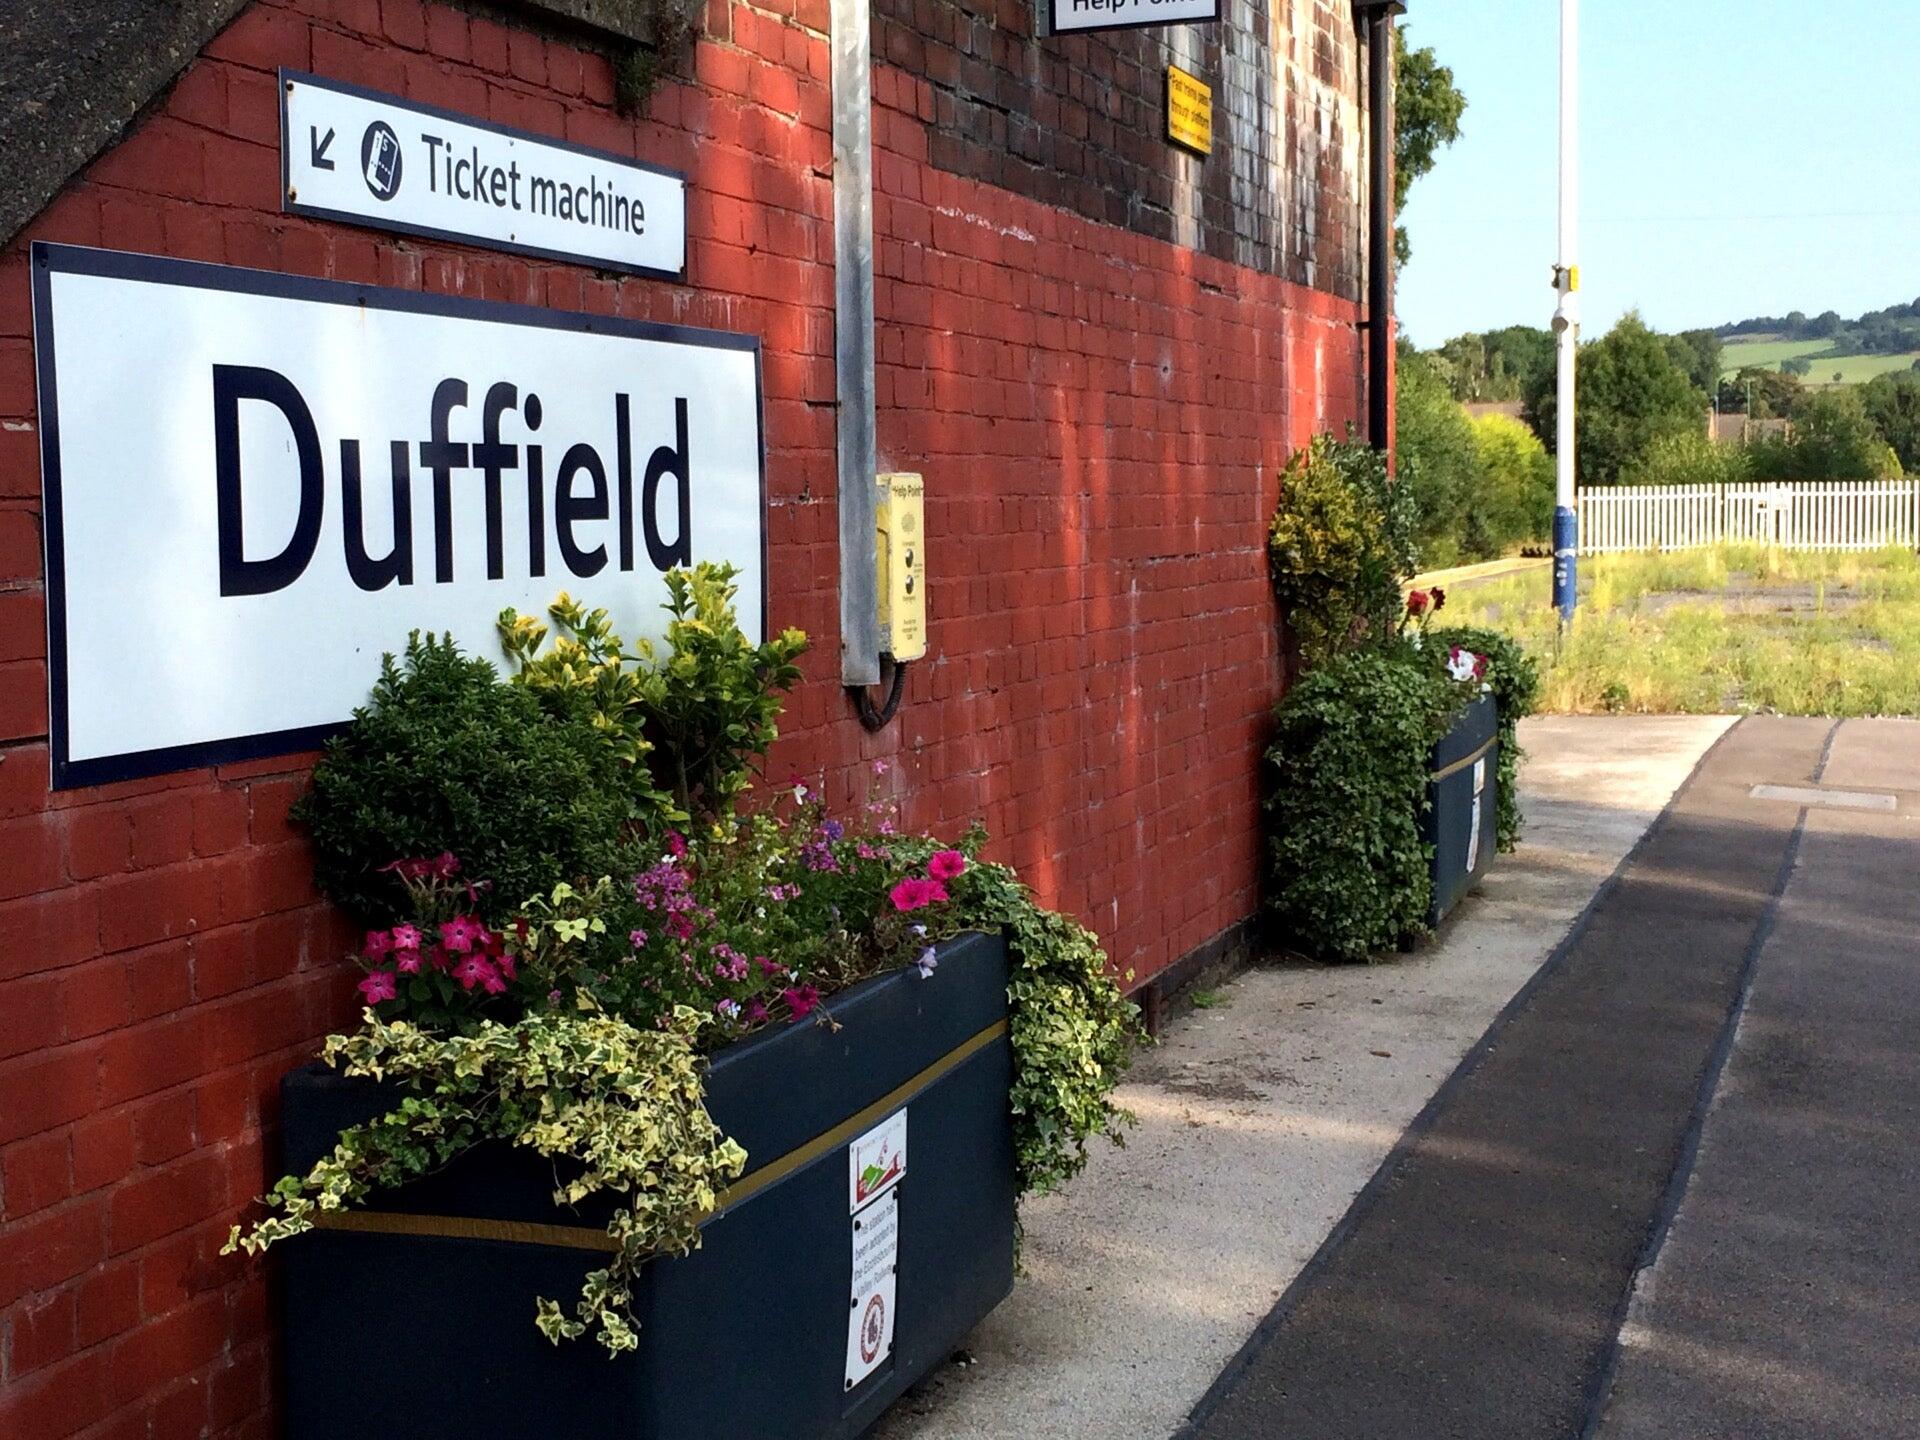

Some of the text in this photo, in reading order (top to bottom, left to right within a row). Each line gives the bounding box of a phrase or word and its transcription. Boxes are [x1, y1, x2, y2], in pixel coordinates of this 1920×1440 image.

[421, 133, 645, 236] Ticket machine
[212, 363, 692, 598] Duffield
